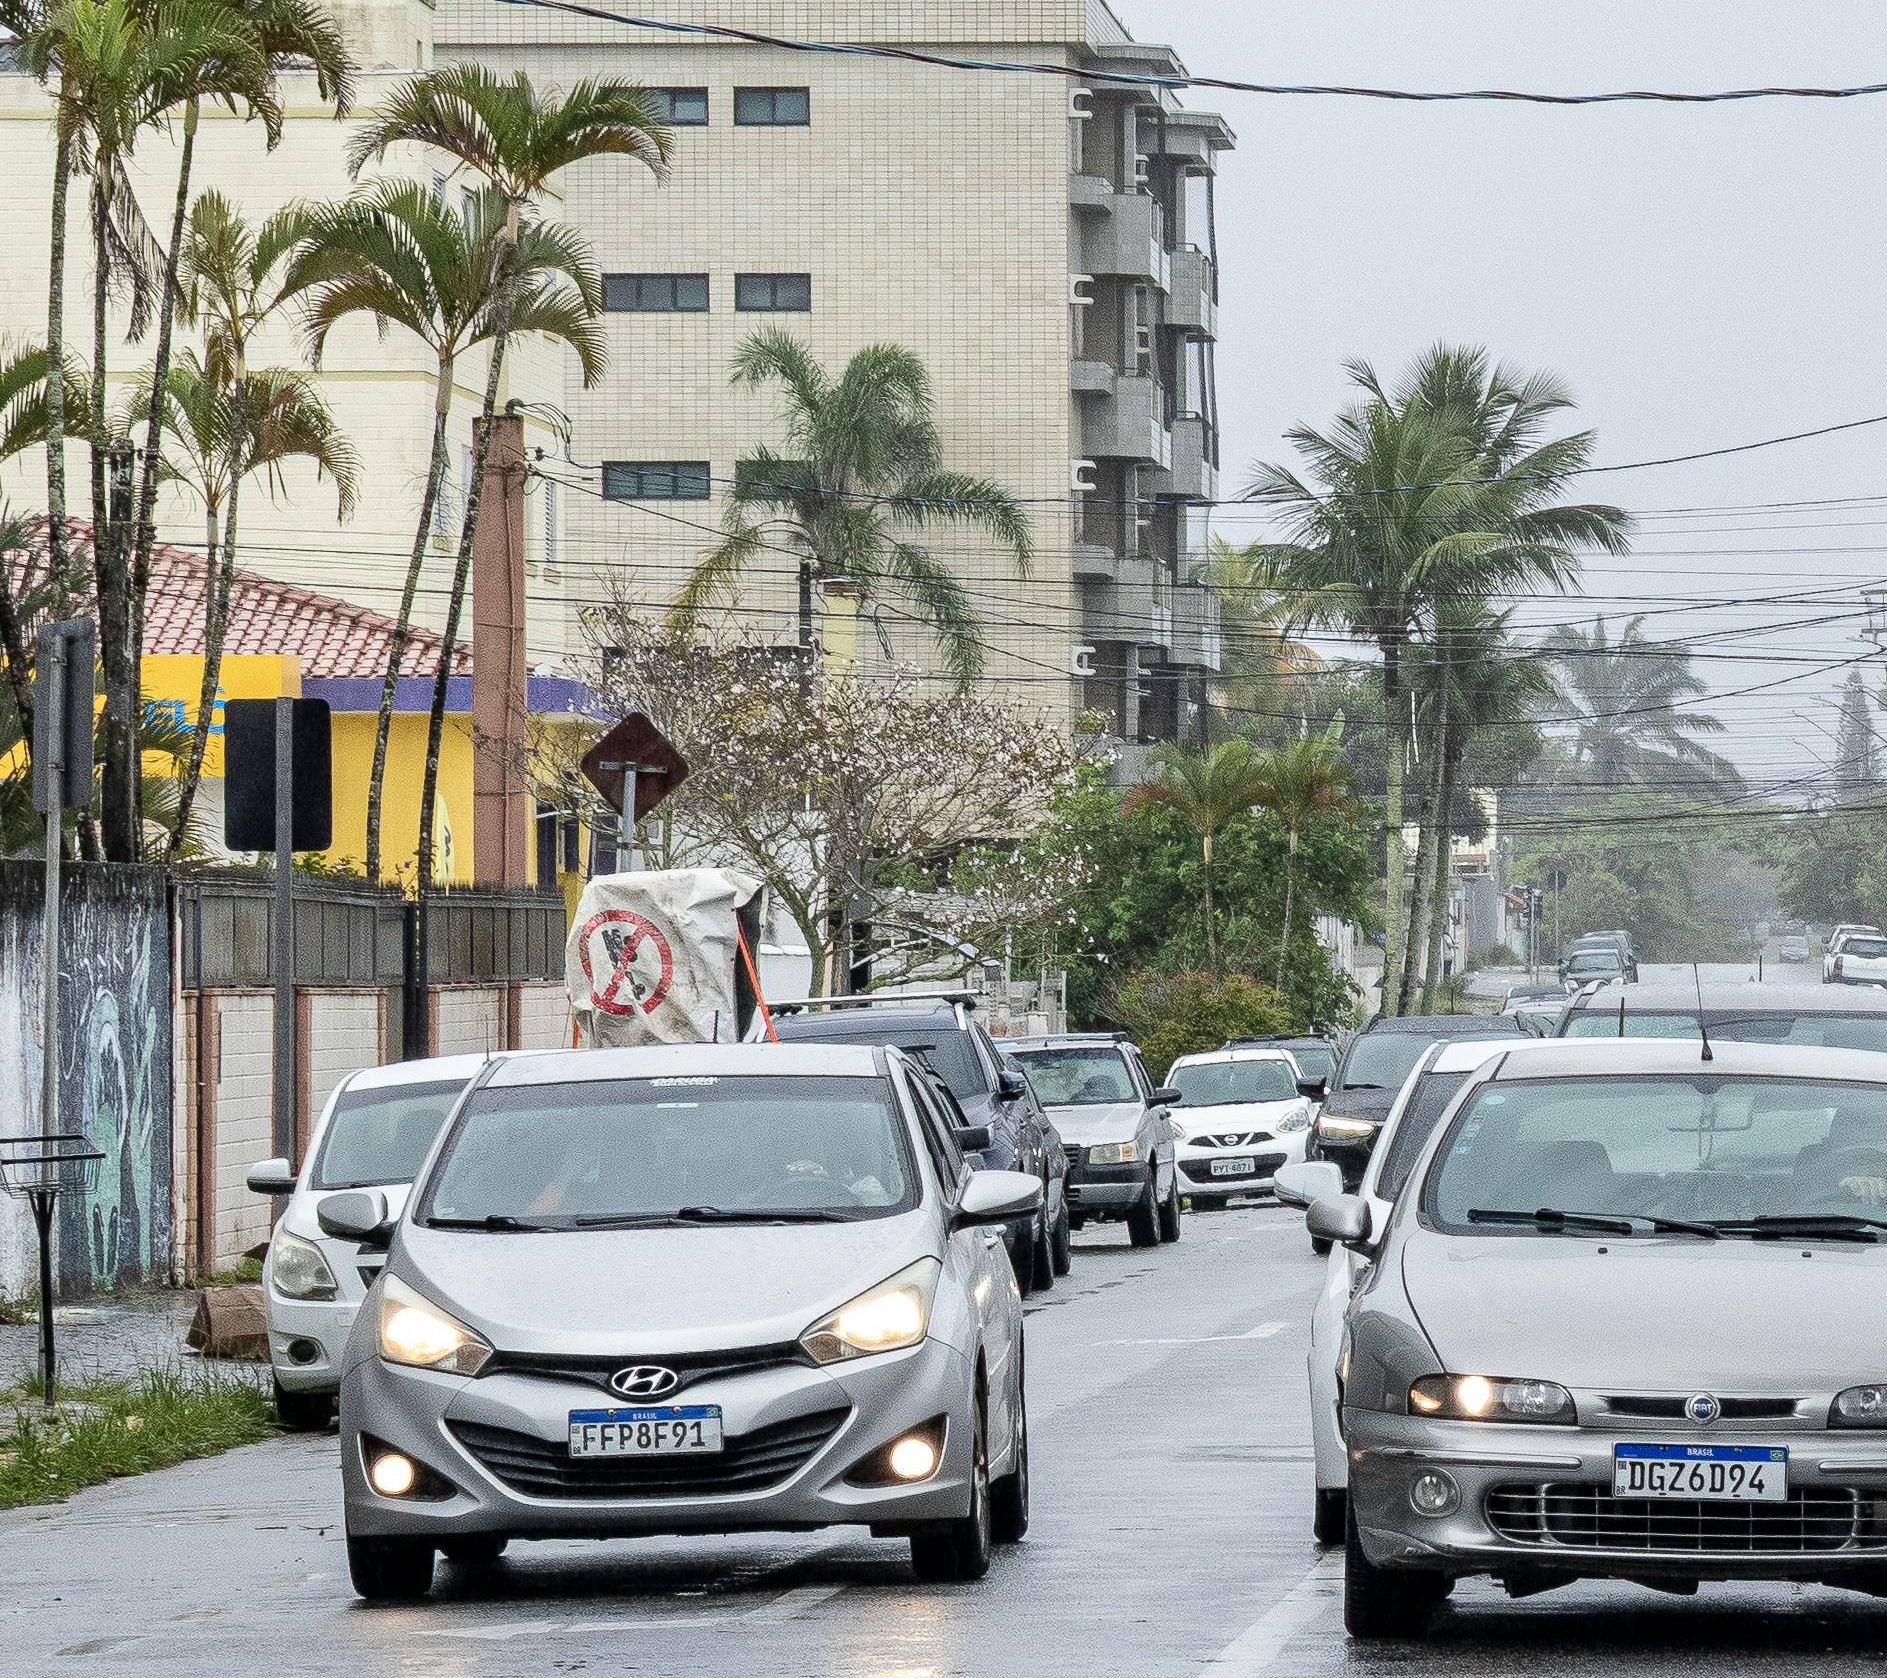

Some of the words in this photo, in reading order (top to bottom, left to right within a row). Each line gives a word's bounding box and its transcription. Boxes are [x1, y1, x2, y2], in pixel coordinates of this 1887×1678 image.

[1693, 1403, 1713, 1413] FIAT
[632, 1412, 657, 1420] BRASIL
[582, 1421, 705, 1451] FFP8F91
[1687, 1447, 1714, 1457] BRASIL
[1628, 1461, 1765, 1494] DGZ6D94
